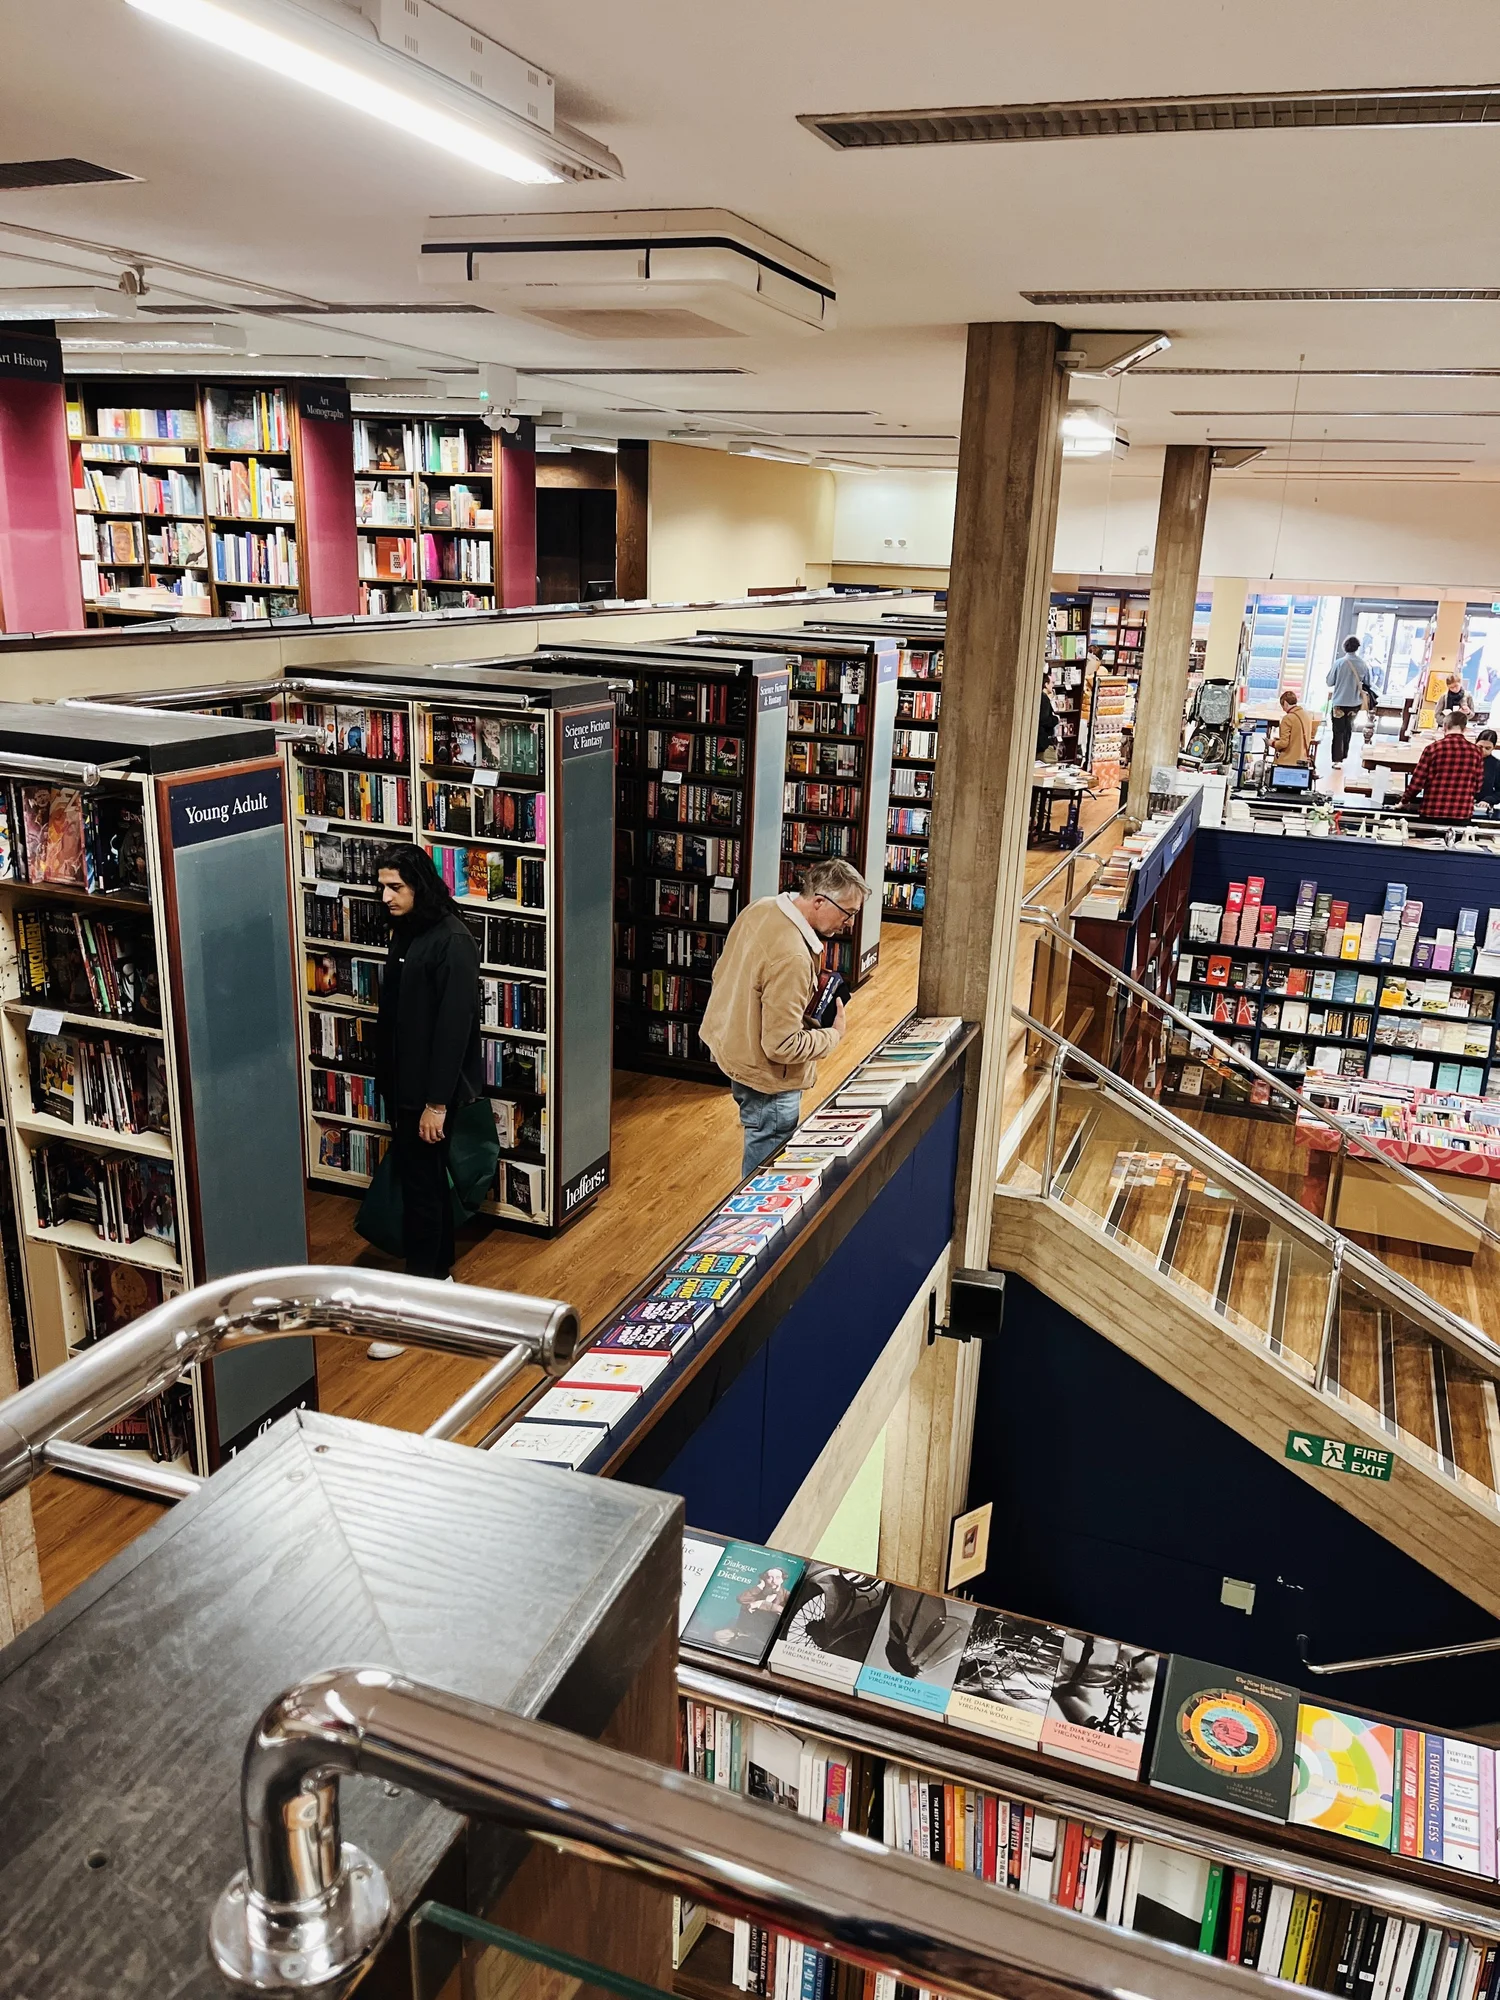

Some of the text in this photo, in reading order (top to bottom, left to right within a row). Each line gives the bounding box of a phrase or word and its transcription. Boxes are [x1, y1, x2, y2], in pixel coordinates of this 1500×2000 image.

[14, 352, 48, 372] History
[319, 396, 329, 406] Art
[306, 404, 344, 420] Monographs
[760, 682, 788, 696] Science Fiction
[767, 695, 782, 705] Fantasy
[564, 719, 611, 738] Science Fiction
[573, 736, 603, 750] & Fantasy
[185, 792, 268, 824] Young Adult
[472, 864, 487, 872] SILVE
[49, 925, 75, 935] SANDM
[26, 923, 45, 987] WATCHMEN
[663, 1301, 681, 1320] FACTS
[639, 1324, 662, 1346] FACTS
[1353, 1447, 1388, 1464] FIRE
[1351, 1462, 1385, 1478] EXIT
[682, 1544, 695, 1555] he
[684, 1564, 704, 1576] ing
[723, 1559, 757, 1573] Dialogue
[716, 1570, 752, 1584] Dickens
[782, 1650, 810, 1662] VIRGINIA
[810, 1657, 833, 1668] WOOLF
[797, 1647, 817, 1656] DIARY
[867, 1676, 921, 1694] VIRGINIA WOOLF
[883, 1673, 904, 1683] DIARY
[1244, 1685, 1282, 1700] Book Review
[1247, 1680, 1260, 1688] New
[1259, 1683, 1274, 1692] York
[1274, 1687, 1292, 1698] Times
[960, 1695, 973, 1703] THE
[974, 1699, 994, 1709] DIARY
[958, 1702, 988, 1714] VIRGINIA
[988, 1710, 1013, 1722] WOOLF
[1070, 1725, 1091, 1736] DIARY
[1053, 1728, 1112, 1749] VIRGINIA WOOLF
[1446, 1749, 1475, 1761] EVERYTHING
[1405, 1770, 1416, 1783] AND
[829, 1766, 845, 1820] HAYWIRE
[1226, 1785, 1253, 1796] LITERARY
[1254, 1792, 1278, 1804] HISTORY
[1328, 1779, 1373, 1796] Cheerfulness
[1404, 1783, 1416, 1798] LESS
[1428, 1753, 1440, 1842] EVERYTHING LESS
[934, 1821, 940, 1829] OF
[1454, 1816, 1468, 1824] MARK
[1010, 1813, 1021, 1851] JOHN GREEN
[1451, 1824, 1471, 1832] McGURL
[816, 1978, 822, 1988] TO
